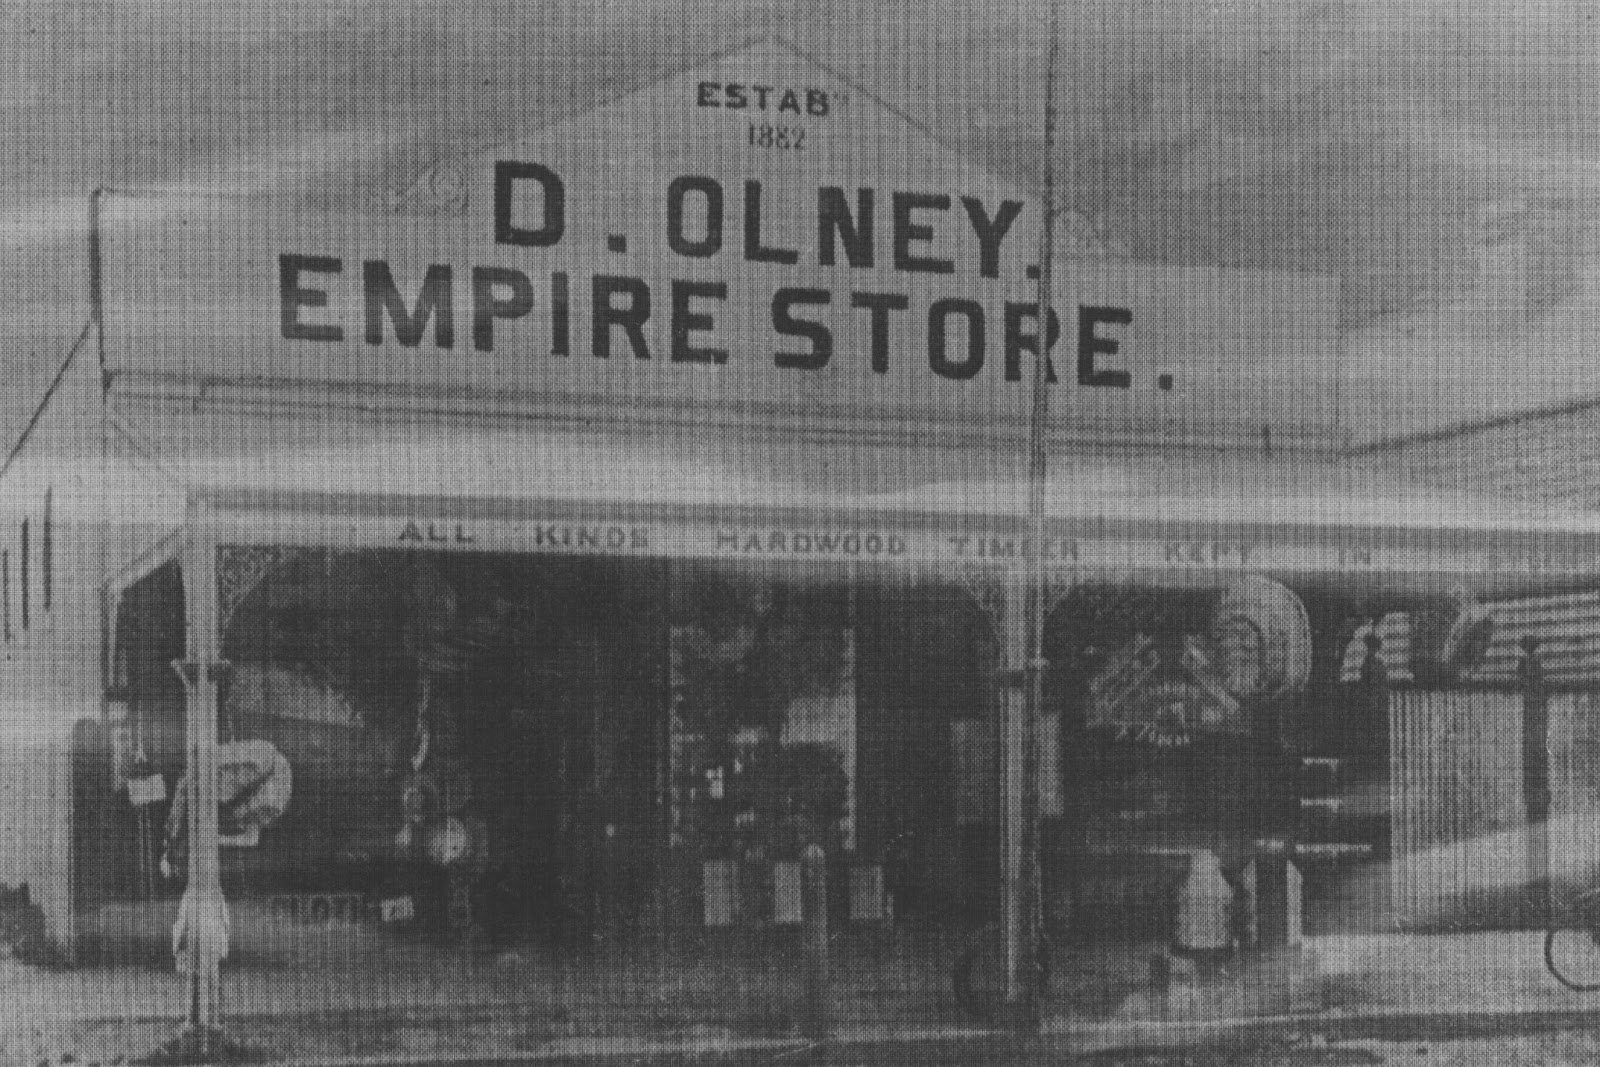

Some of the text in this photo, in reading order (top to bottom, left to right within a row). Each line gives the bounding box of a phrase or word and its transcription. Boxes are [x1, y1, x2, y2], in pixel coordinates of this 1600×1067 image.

[749, 123, 806, 151] 1882
[667, 175, 1043, 279] OLNEY.
[279, 253, 1176, 391] EMPIRE STORE.
[398, 521, 475, 545] ALL
[535, 525, 650, 551] KINDS
[716, 526, 907, 557] HARDWOOD
